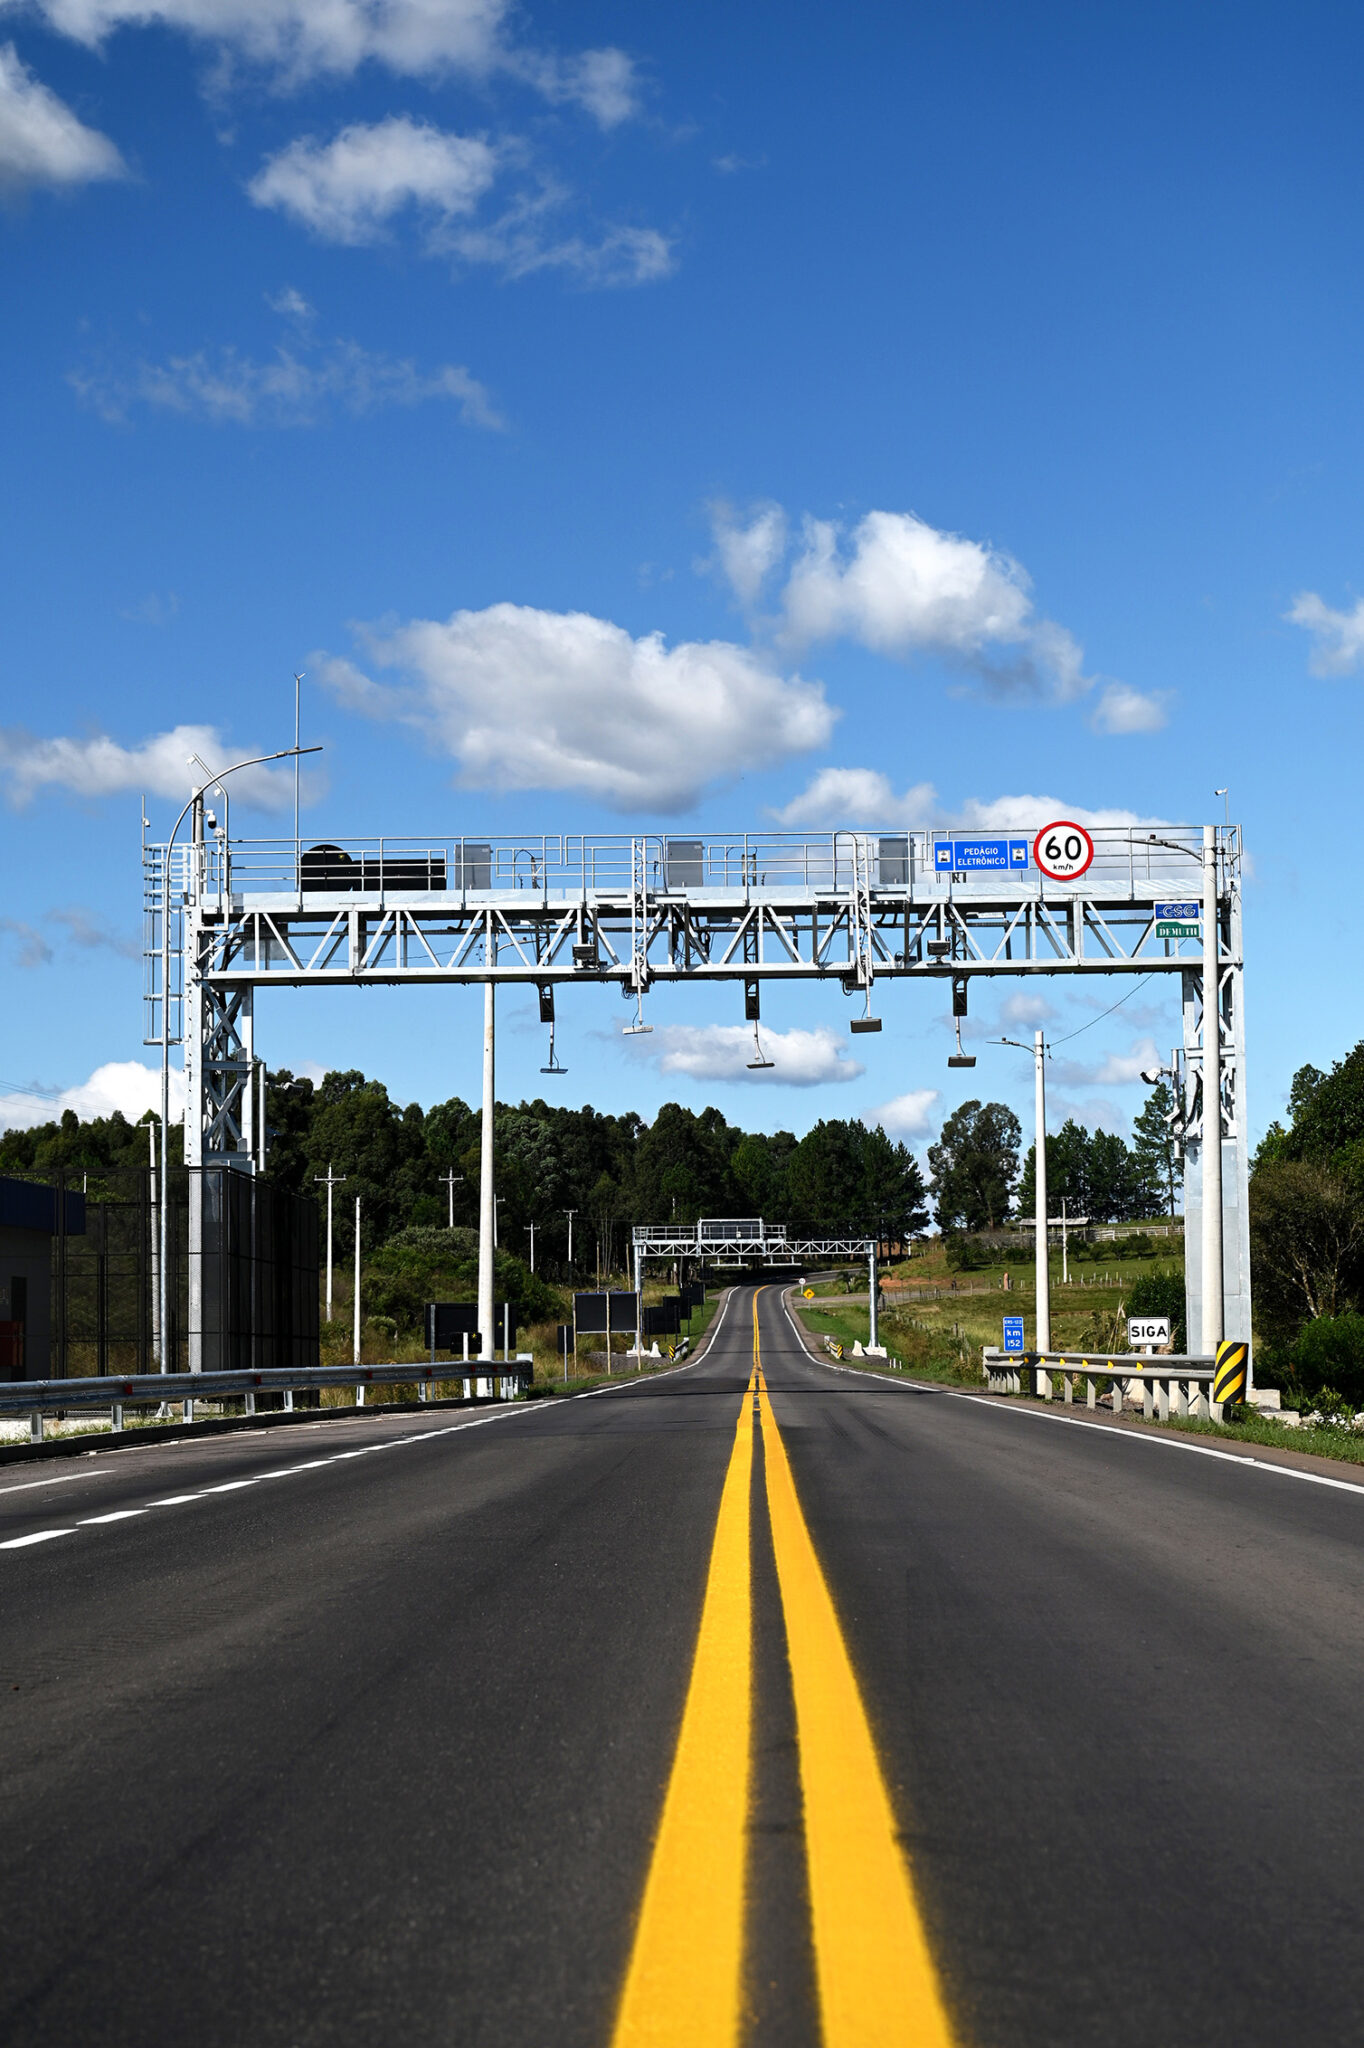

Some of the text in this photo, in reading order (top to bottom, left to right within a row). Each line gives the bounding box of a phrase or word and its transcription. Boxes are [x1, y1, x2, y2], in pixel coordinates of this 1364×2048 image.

[964, 846, 999, 855] PEDÁGIO
[1045, 835, 1082, 860] 60
[957, 856, 1006, 866] ELETRÔNICO
[1052, 863, 1074, 871] km/h
[1162, 905, 1196, 917] CSG
[1131, 1325, 1167, 1337] SIGA
[1007, 1339, 1021, 1347] 152
